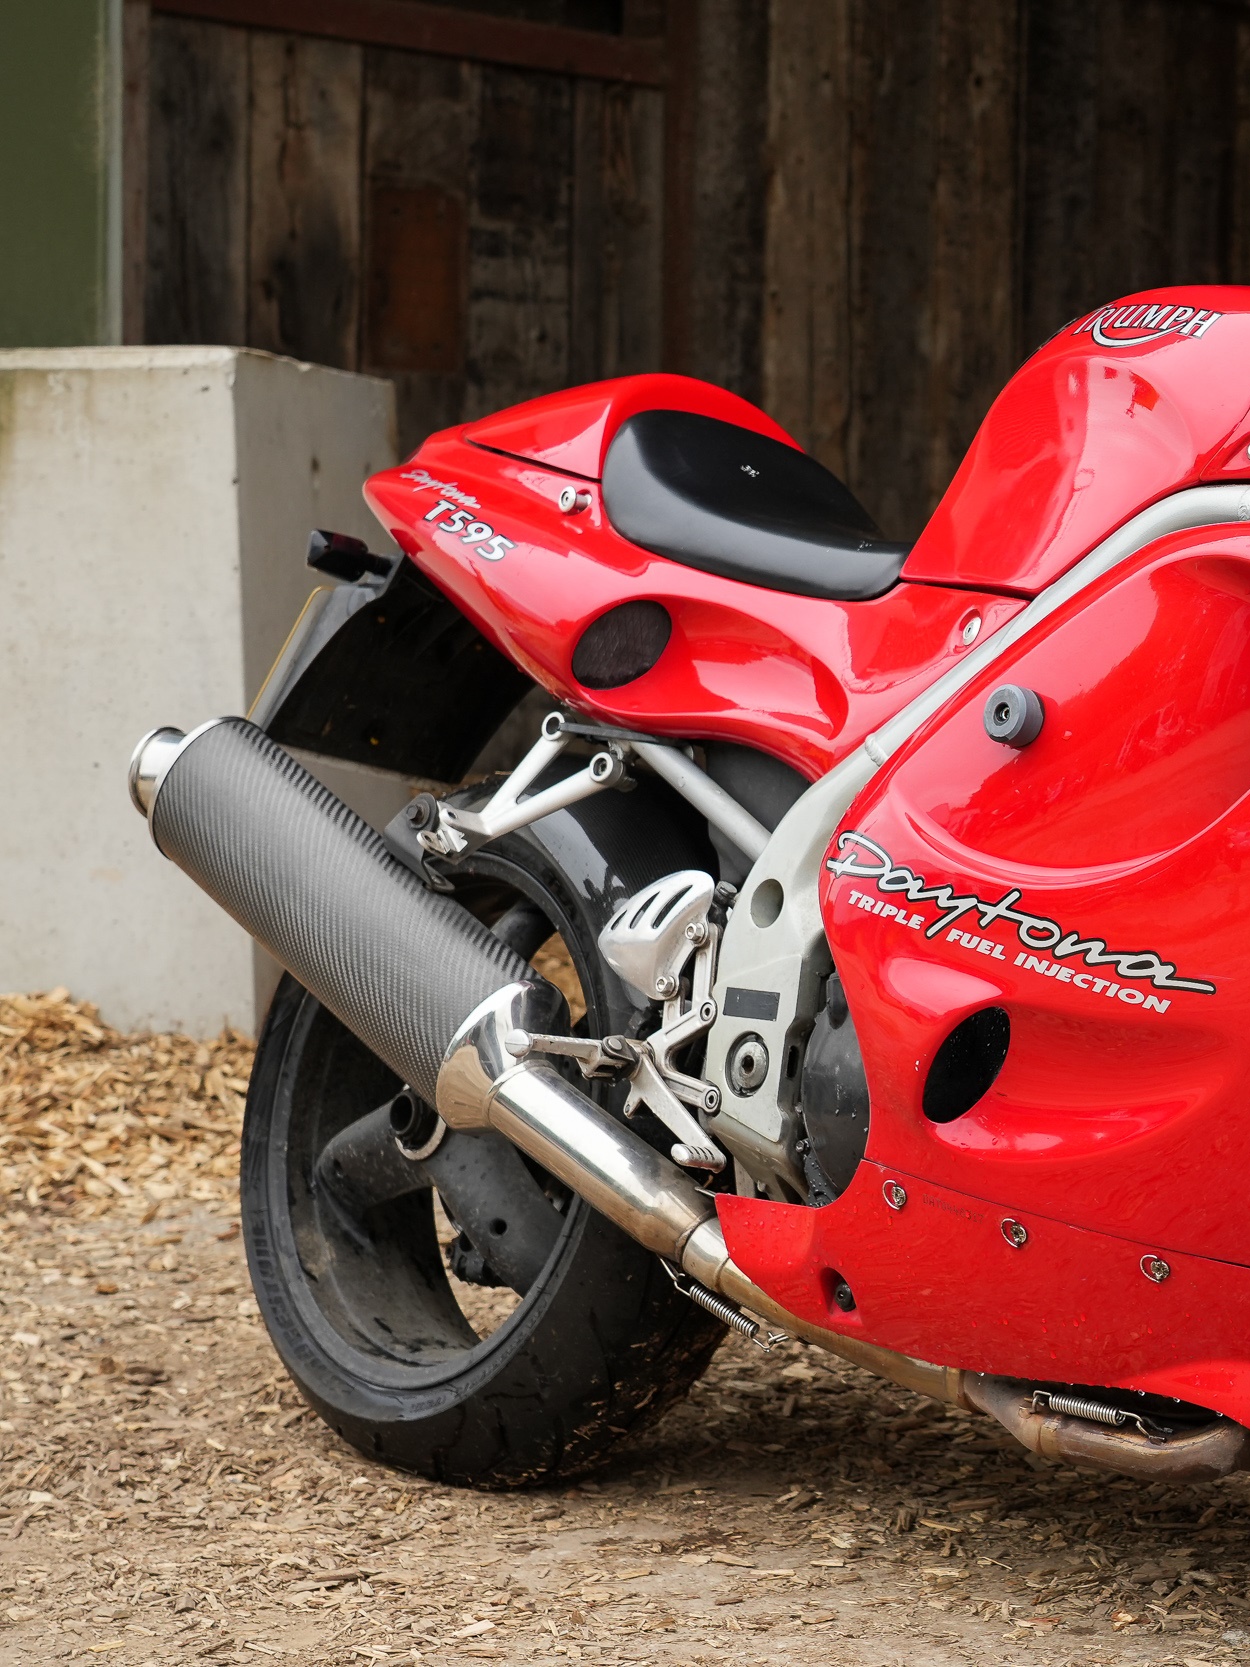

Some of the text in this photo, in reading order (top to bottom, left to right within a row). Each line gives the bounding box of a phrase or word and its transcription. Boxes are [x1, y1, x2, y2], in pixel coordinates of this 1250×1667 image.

[1071, 302, 1224, 348] TRIUMPH
[423, 499, 518, 562] T595
[825, 830, 1217, 995] Daytona
[848, 889, 1173, 1015] TRIPLE FUEL INJECTION
